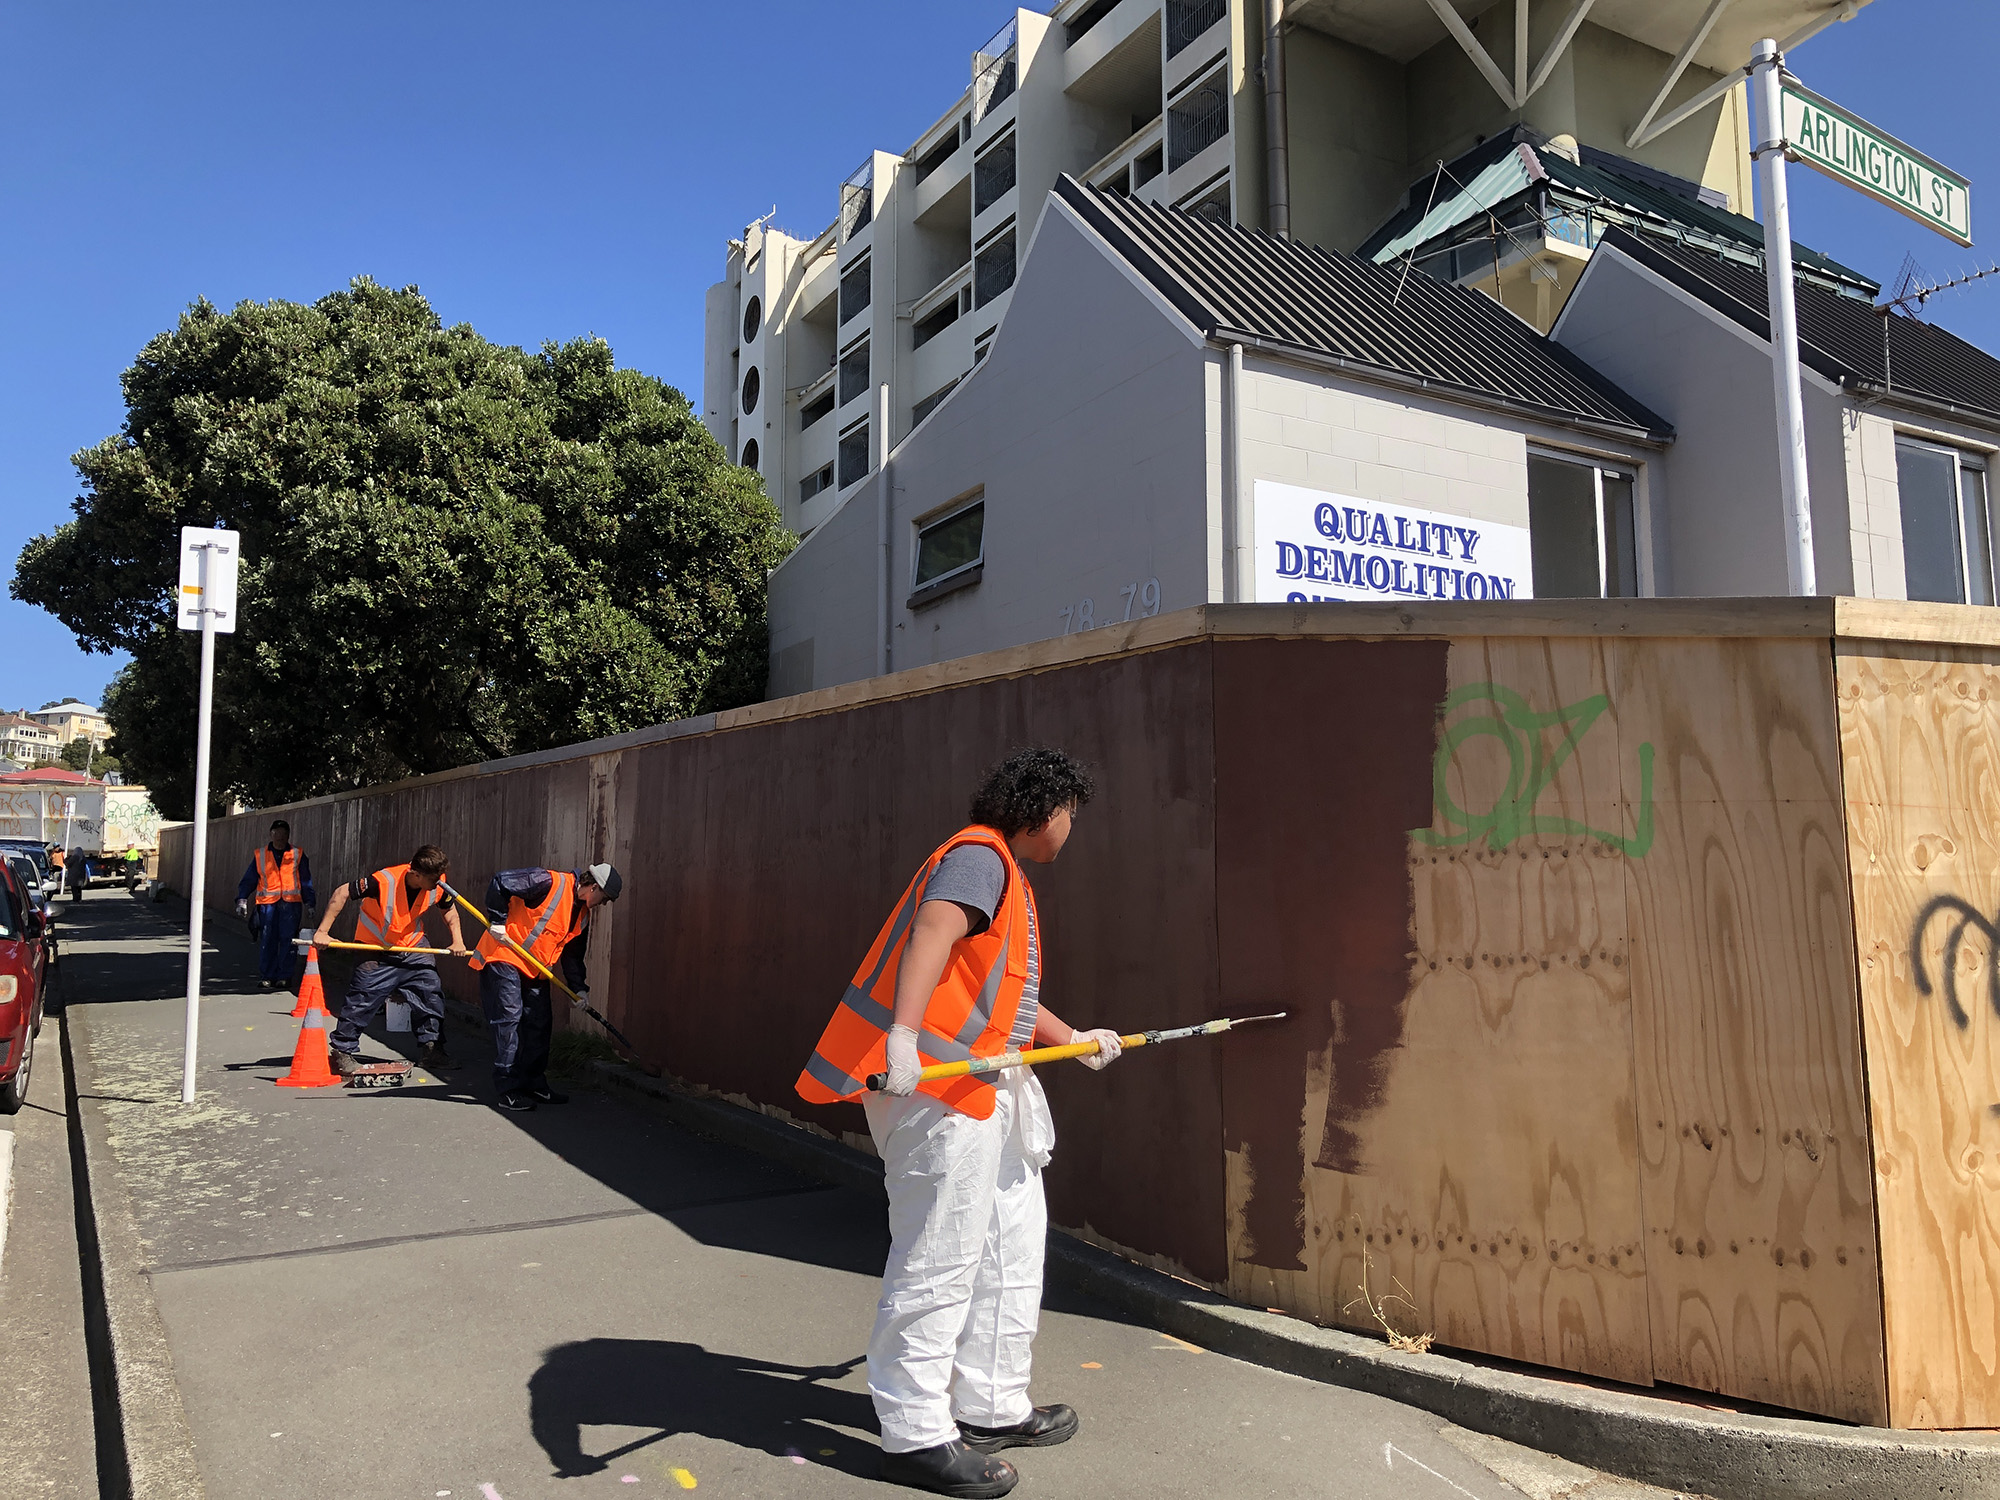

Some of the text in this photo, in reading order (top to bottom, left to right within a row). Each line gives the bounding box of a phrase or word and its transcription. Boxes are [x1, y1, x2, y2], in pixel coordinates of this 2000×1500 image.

[1799, 106, 1954, 223] ARLINGTON ST
[1313, 502, 1480, 564] QUALITY
[1275, 540, 1515, 601] DEMOLITION
